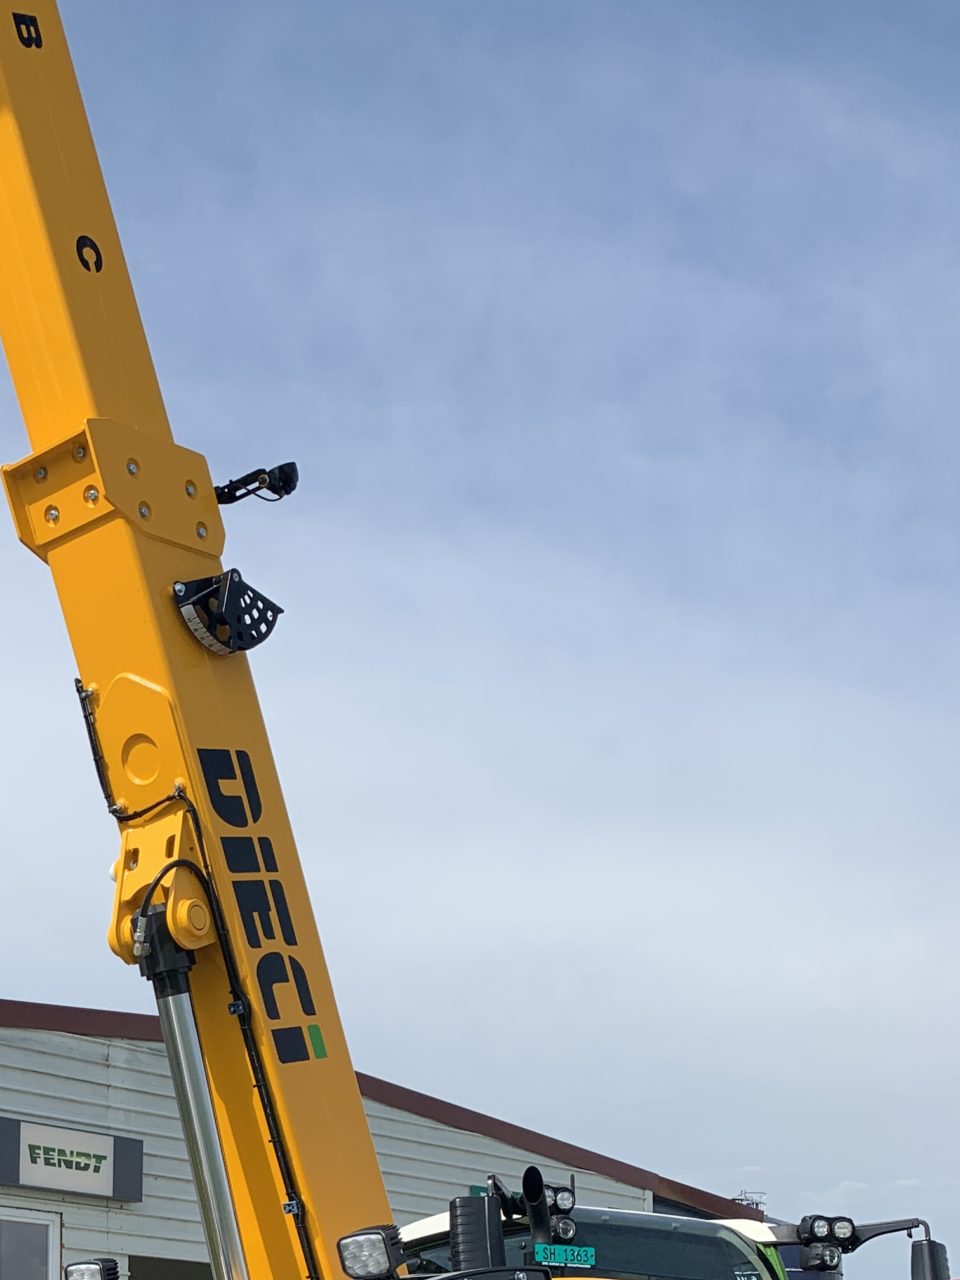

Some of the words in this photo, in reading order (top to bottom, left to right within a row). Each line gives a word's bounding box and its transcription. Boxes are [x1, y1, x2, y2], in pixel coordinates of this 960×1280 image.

[11, 11, 43, 49] B
[75, 234, 103, 274] C
[196, 747, 328, 1065] DIECI
[27, 1143, 108, 1174] FENDT
[542, 1246, 556, 1261] SH
[563, 1247, 589, 1263] 1363
